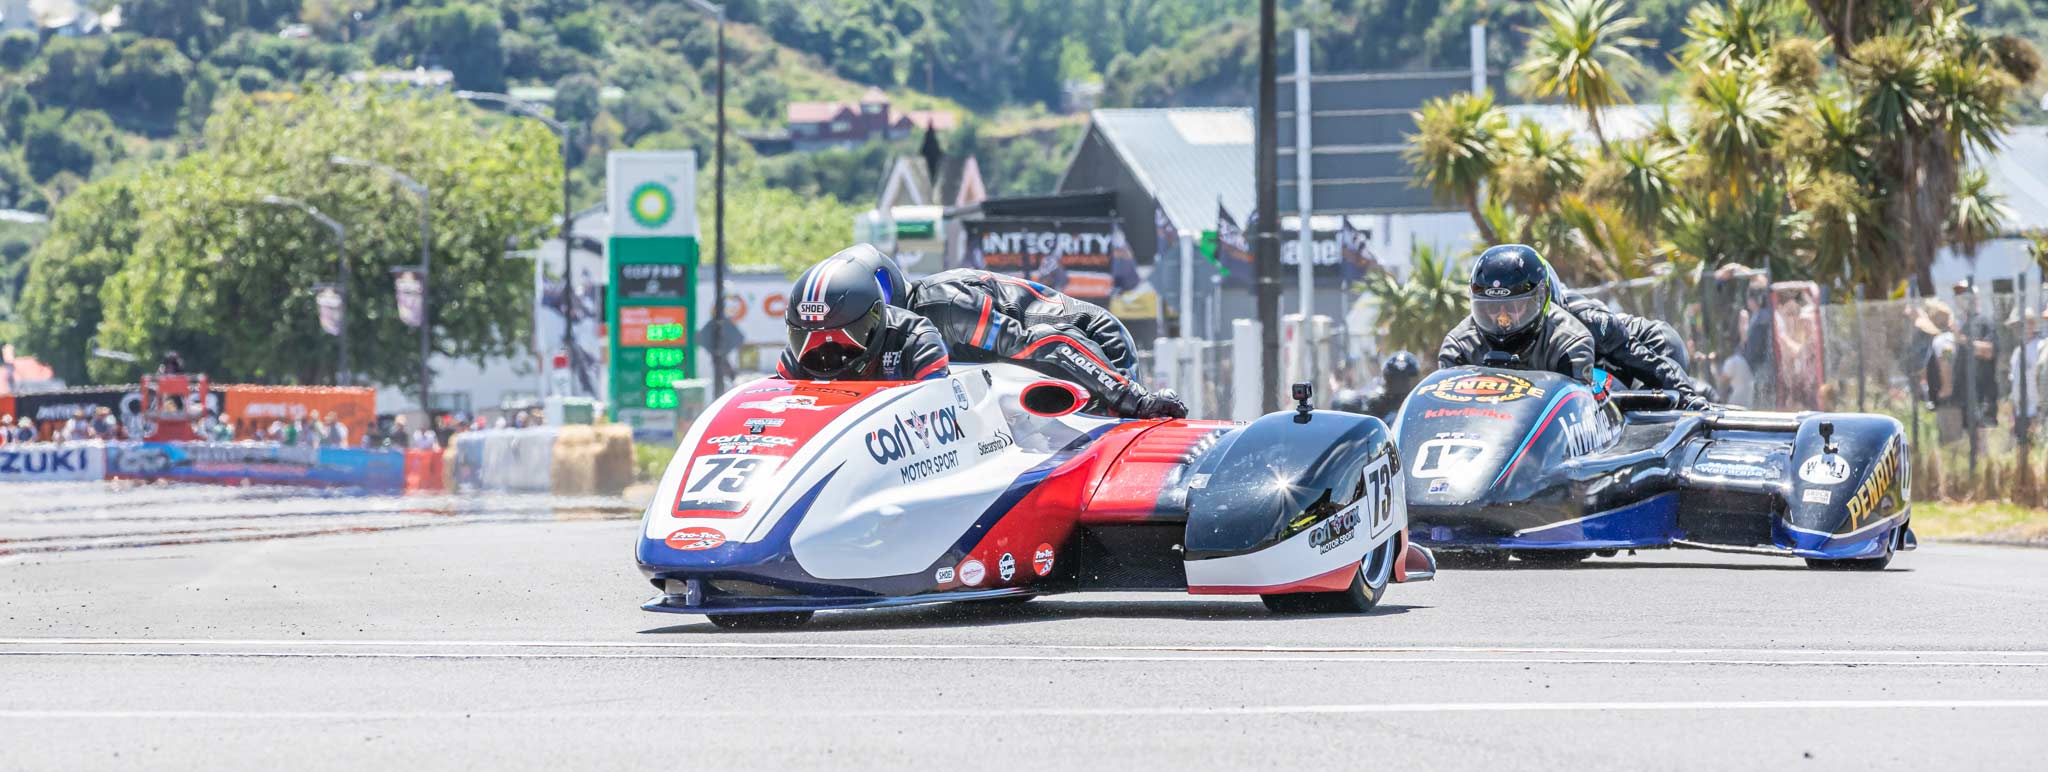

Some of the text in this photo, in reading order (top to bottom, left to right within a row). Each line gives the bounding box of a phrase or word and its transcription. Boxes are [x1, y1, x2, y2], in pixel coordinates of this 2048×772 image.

[983, 232, 1112, 254] INTEGRITY
[801, 304, 824, 313] SHOEI
[1417, 380, 1545, 398] PENRITE
[687, 457, 762, 493] 73
[900, 450, 959, 484] MOTOR SPORT
[1369, 464, 1391, 529] 73
[1320, 529, 1355, 555] MOTOR SPORT
[938, 571, 953, 579] SHOEI
